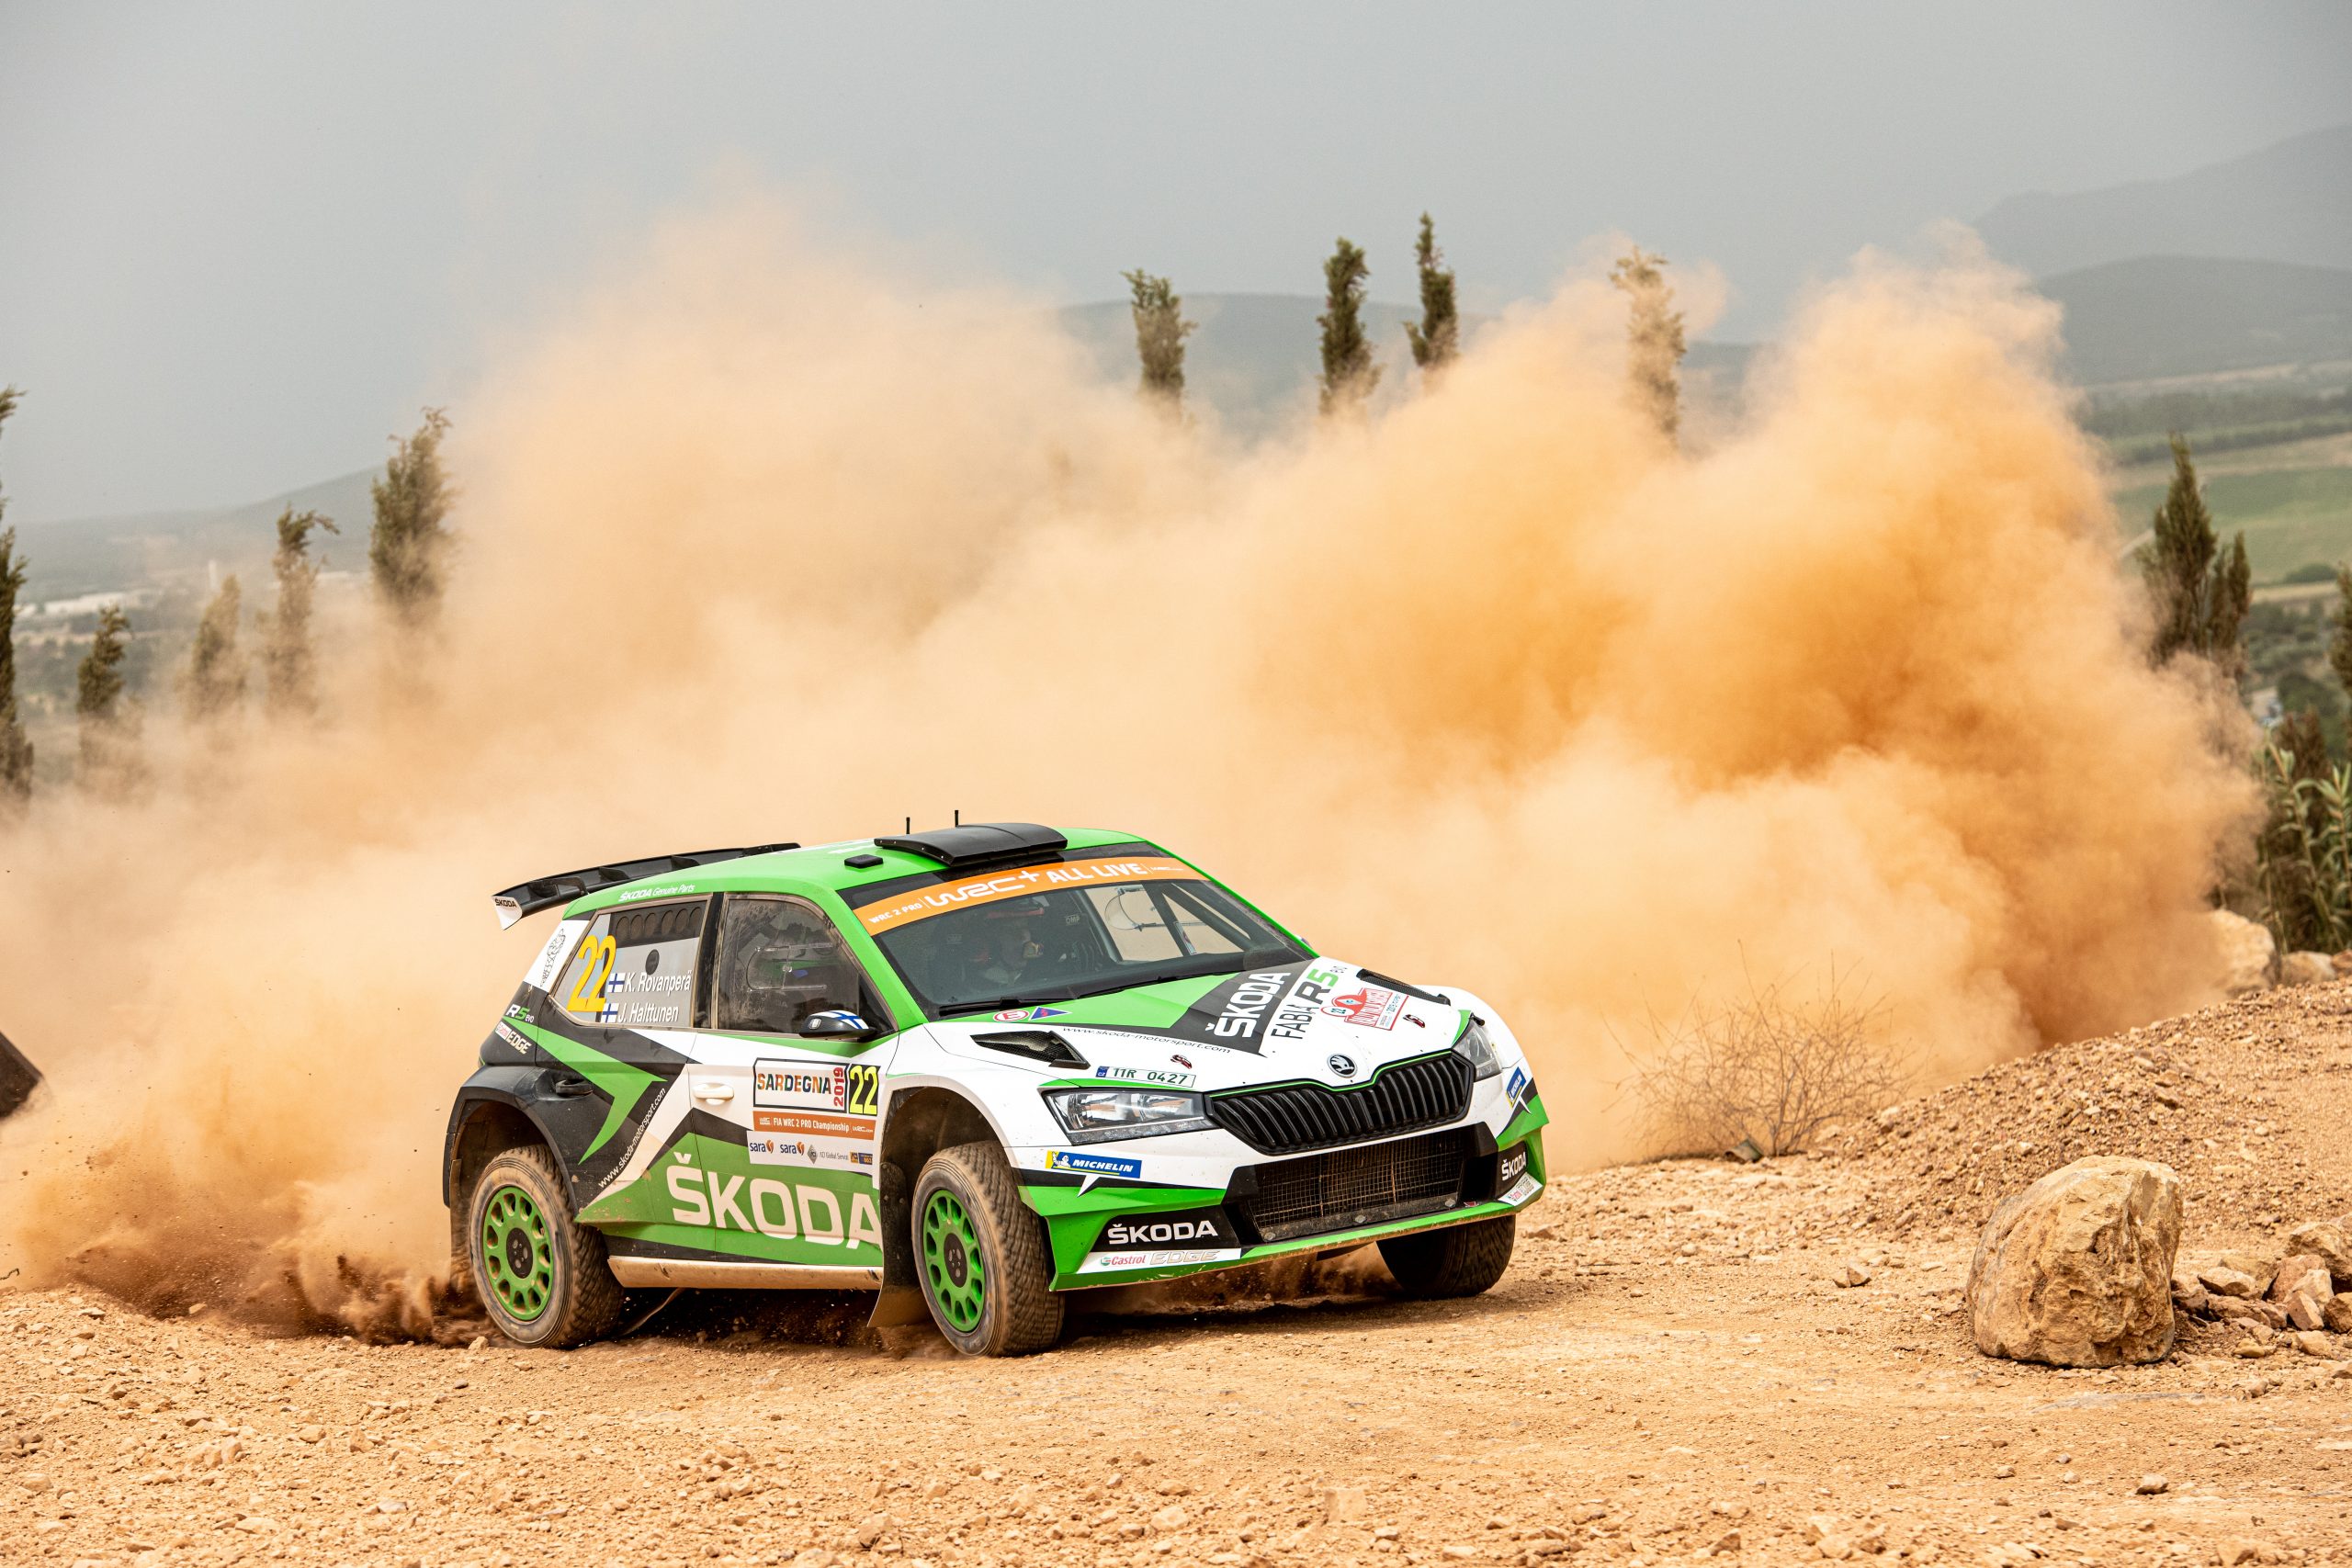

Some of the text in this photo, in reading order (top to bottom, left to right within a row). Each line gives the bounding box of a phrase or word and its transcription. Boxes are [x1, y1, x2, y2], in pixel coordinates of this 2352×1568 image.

[1046, 866, 1094, 884] ALL
[1093, 863, 1148, 878] LIVE
[494, 898, 517, 908] ŠKODA
[618, 884, 695, 902] ŠKODA Genuine Parts
[901, 903, 923, 912] PRO
[567, 934, 616, 1012] 22
[625, 970, 693, 997] K. Rovanperä
[1295, 968, 1340, 1006] R5
[617, 1002, 679, 1022] J. Halttunen
[1204, 972, 1292, 1038] ŠKODA
[1271, 1004, 1320, 1040] FABIA
[505, 1031, 532, 1055] EDGE
[1062, 1026, 1231, 1055] www.skoda-motorsport.com
[757, 1073, 832, 1095] SARDEGNA
[833, 1066, 844, 1108] 2019
[849, 1065, 878, 1115] 22
[1147, 1071, 1188, 1085] 0427
[773, 1117, 783, 1126] FIA
[783, 1118, 795, 1127] WRC
[796, 1119, 800, 1128] 2
[800, 1119, 811, 1129] PRO
[812, 1120, 850, 1133] Championship
[598, 1088, 666, 1189] www.skoda-motorsport.com
[750, 1142, 766, 1153] sara
[780, 1144, 797, 1155] sara
[1072, 1159, 1134, 1173] MICHELIN
[1501, 1152, 1527, 1181] ŠKODA
[666, 1151, 883, 1250] ŠKODA
[1107, 1220, 1219, 1245] ŠKODA
[1111, 1249, 1221, 1266] Castrol EDGE
